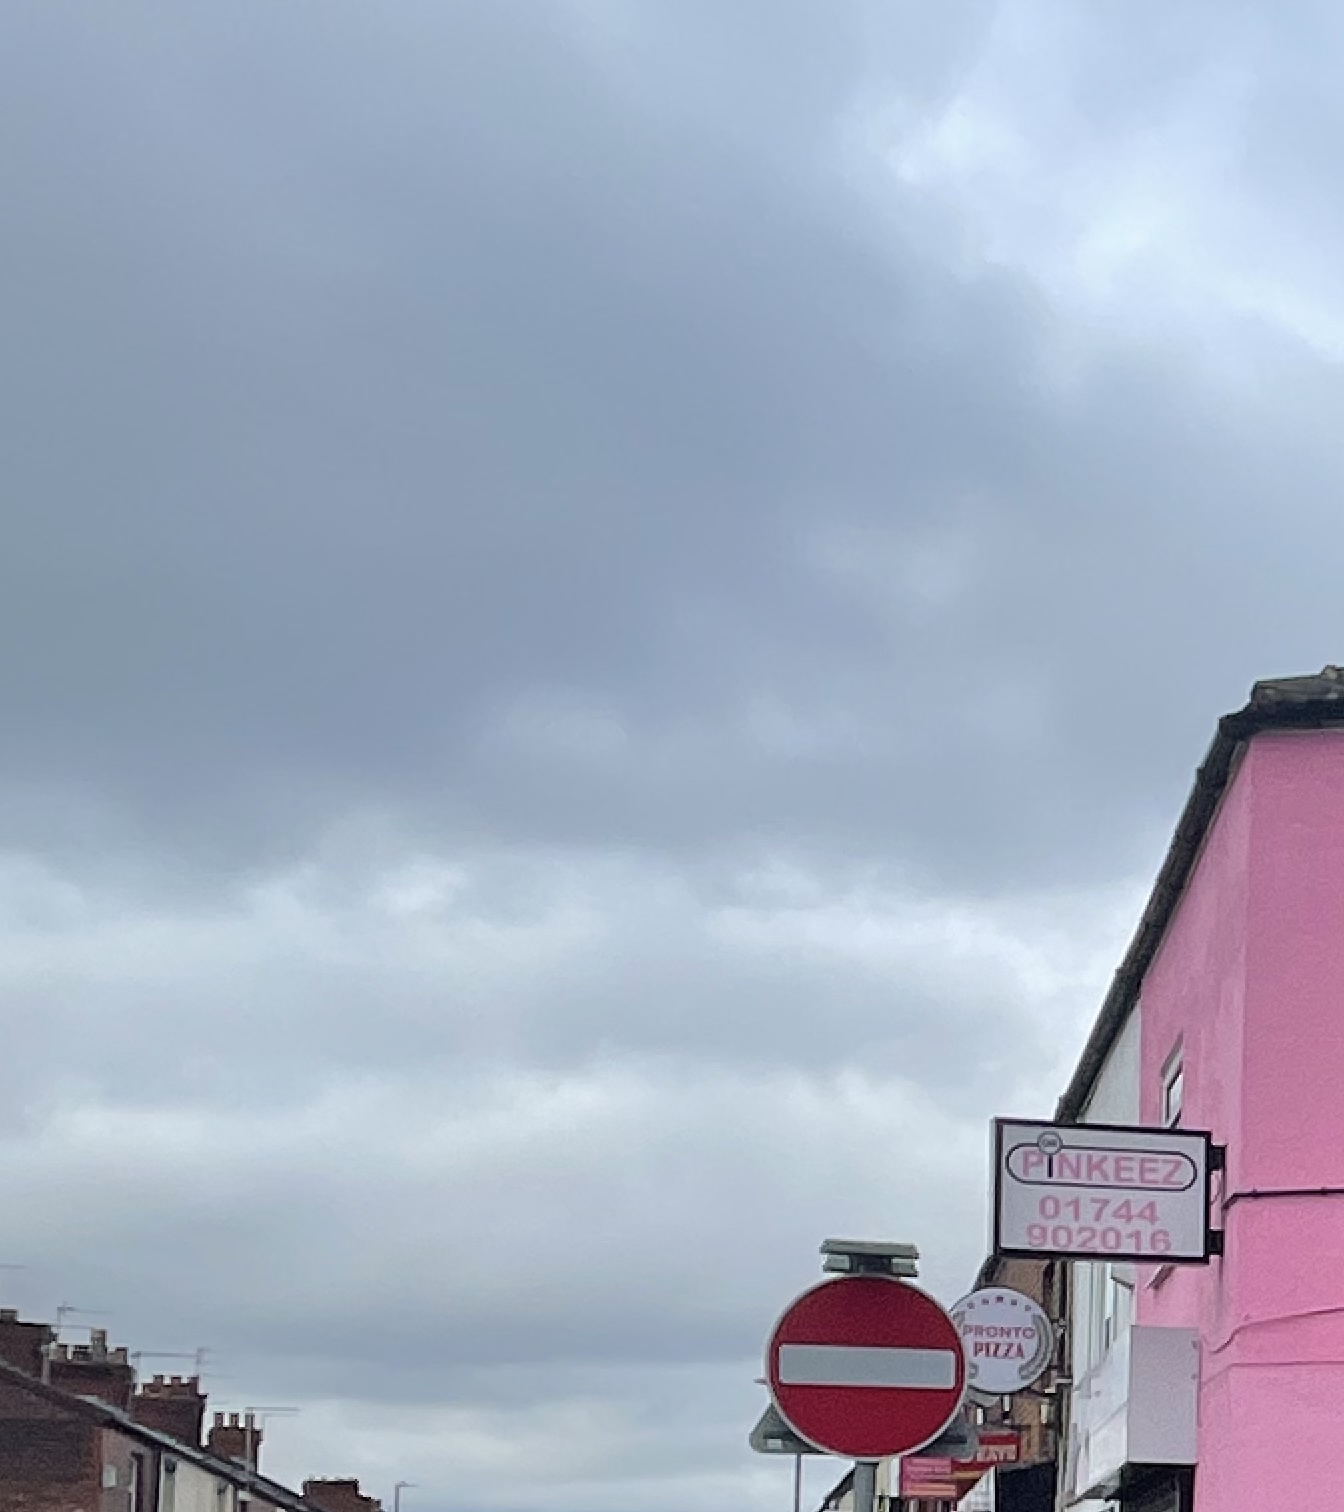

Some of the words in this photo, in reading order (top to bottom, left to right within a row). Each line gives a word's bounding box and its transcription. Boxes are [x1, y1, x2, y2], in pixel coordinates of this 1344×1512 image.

[1038, 1195, 1160, 1225] 01744
[1026, 1224, 1172, 1253] 902016
[963, 1325, 1036, 1340] PRONTO
[974, 1341, 1025, 1359] PIZZA
